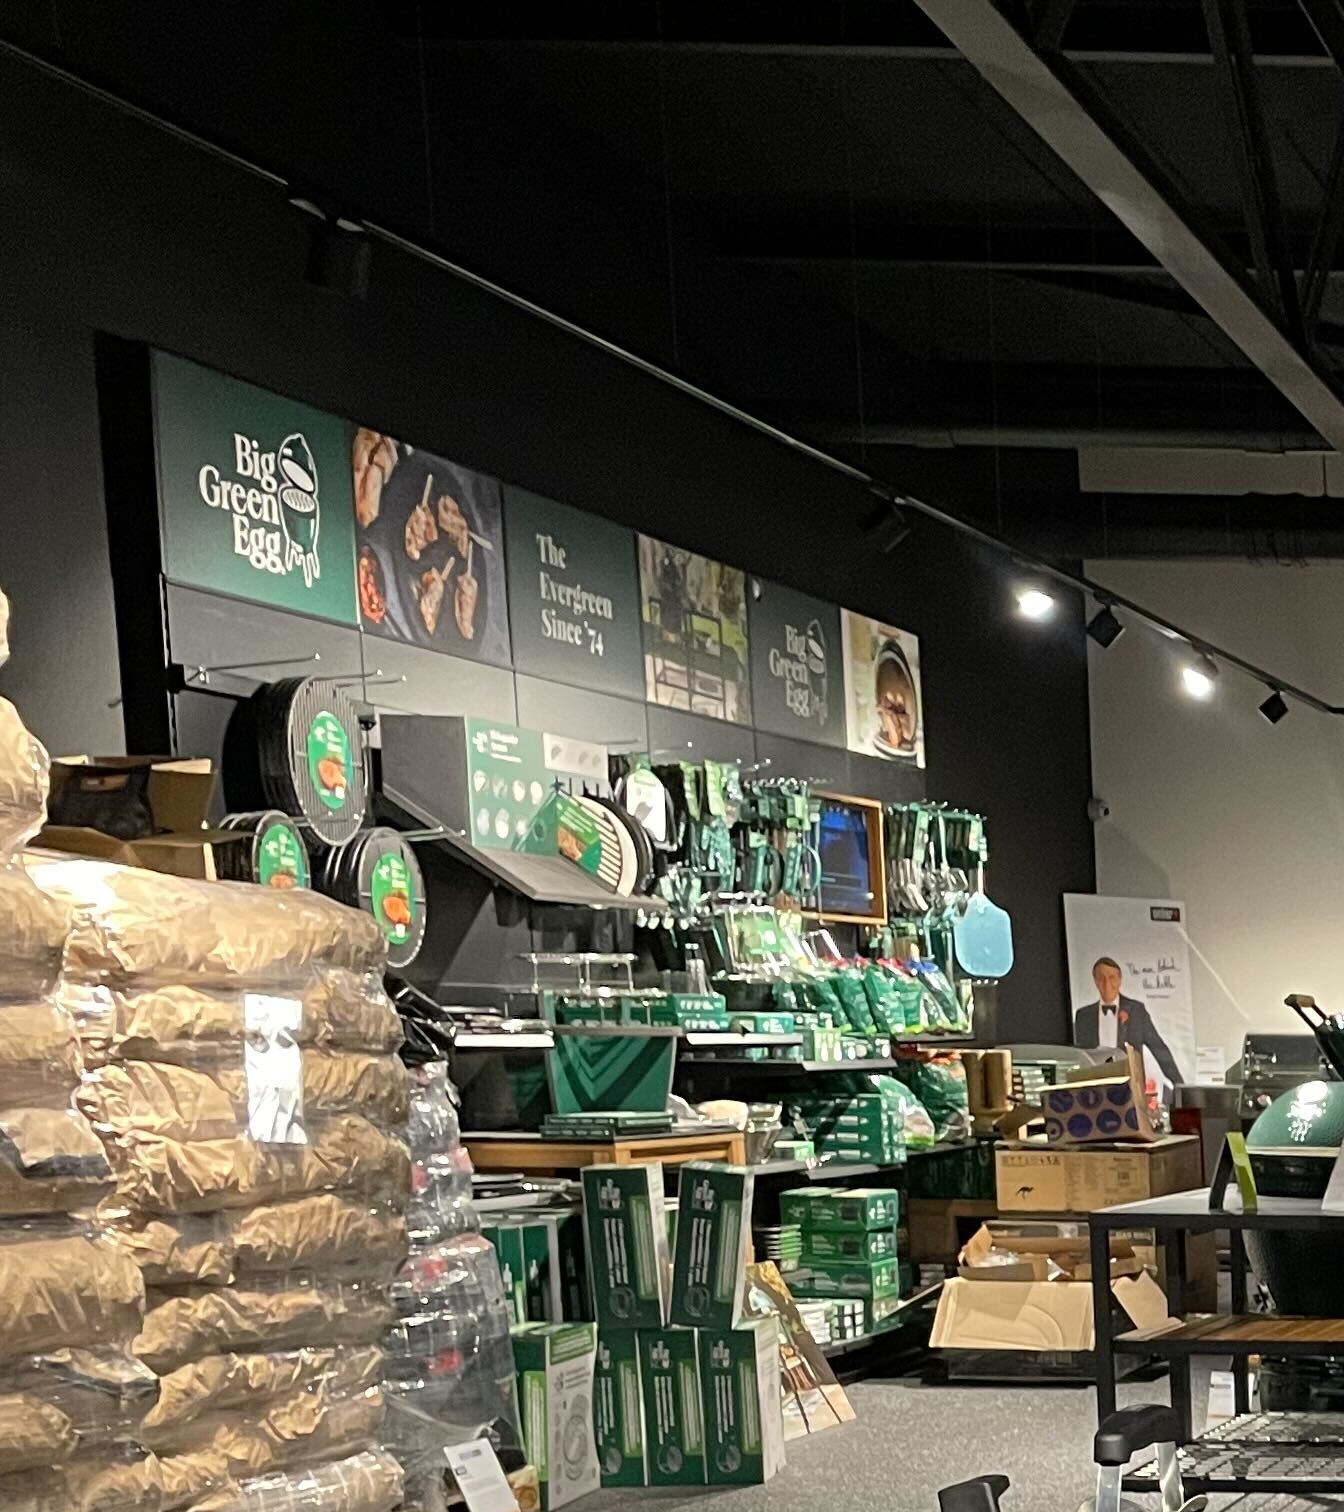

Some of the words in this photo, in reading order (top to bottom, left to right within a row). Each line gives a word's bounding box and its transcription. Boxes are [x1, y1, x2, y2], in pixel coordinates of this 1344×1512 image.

[234, 433, 277, 493] Big
[199, 464, 280, 526] Green
[536, 532, 566, 569] The
[540, 571, 613, 620] Evergreen
[541, 608, 582, 645] Since
[785, 624, 807, 663] Big
[769, 648, 808, 685] Green
